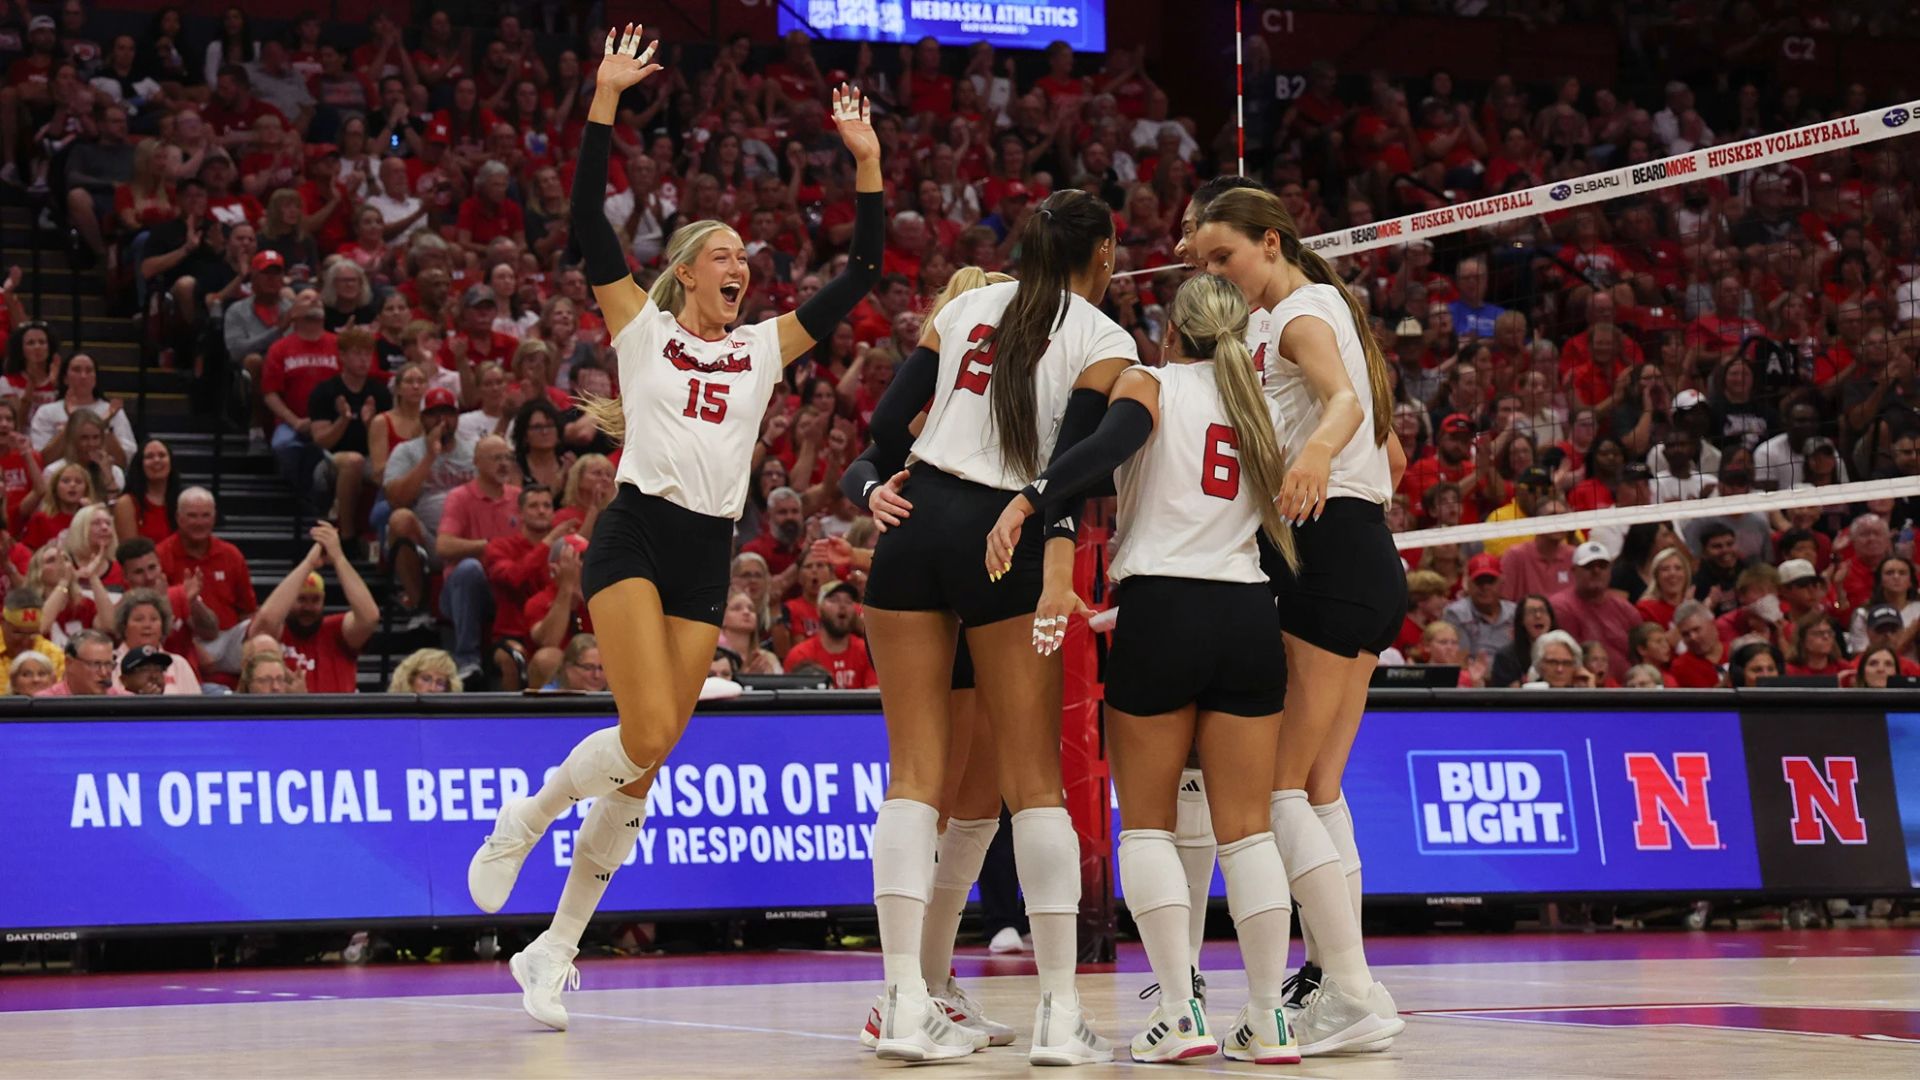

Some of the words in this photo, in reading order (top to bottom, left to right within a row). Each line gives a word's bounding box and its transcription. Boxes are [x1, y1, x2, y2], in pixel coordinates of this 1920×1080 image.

[995, 4, 1079, 28] ATHLETICS
[1262, 9, 1294, 33] C1
[1783, 36, 1815, 60] C2
[1275, 75, 1306, 100] B2
[1350, 220, 1402, 245] BEARDMORE
[1411, 209, 1455, 232] HUSKER
[1456, 191, 1534, 221] VOLLEYBALL
[1573, 175, 1620, 194] SUBARU
[1632, 155, 1697, 185] BEARDMORE
[1707, 142, 1763, 168] HUSKER
[1765, 118, 1860, 155] VOLLEYBALL
[683, 377, 730, 425] 15
[1201, 422, 1240, 501] 6
[70, 772, 142, 828] AN
[159, 769, 393, 828] OFFICIAL
[781, 762, 838, 816] OF
[1437, 761, 1542, 802] BUD
[1624, 752, 1721, 850] N
[1781, 756, 1868, 844] N
[1423, 801, 1564, 844] LIGHT
